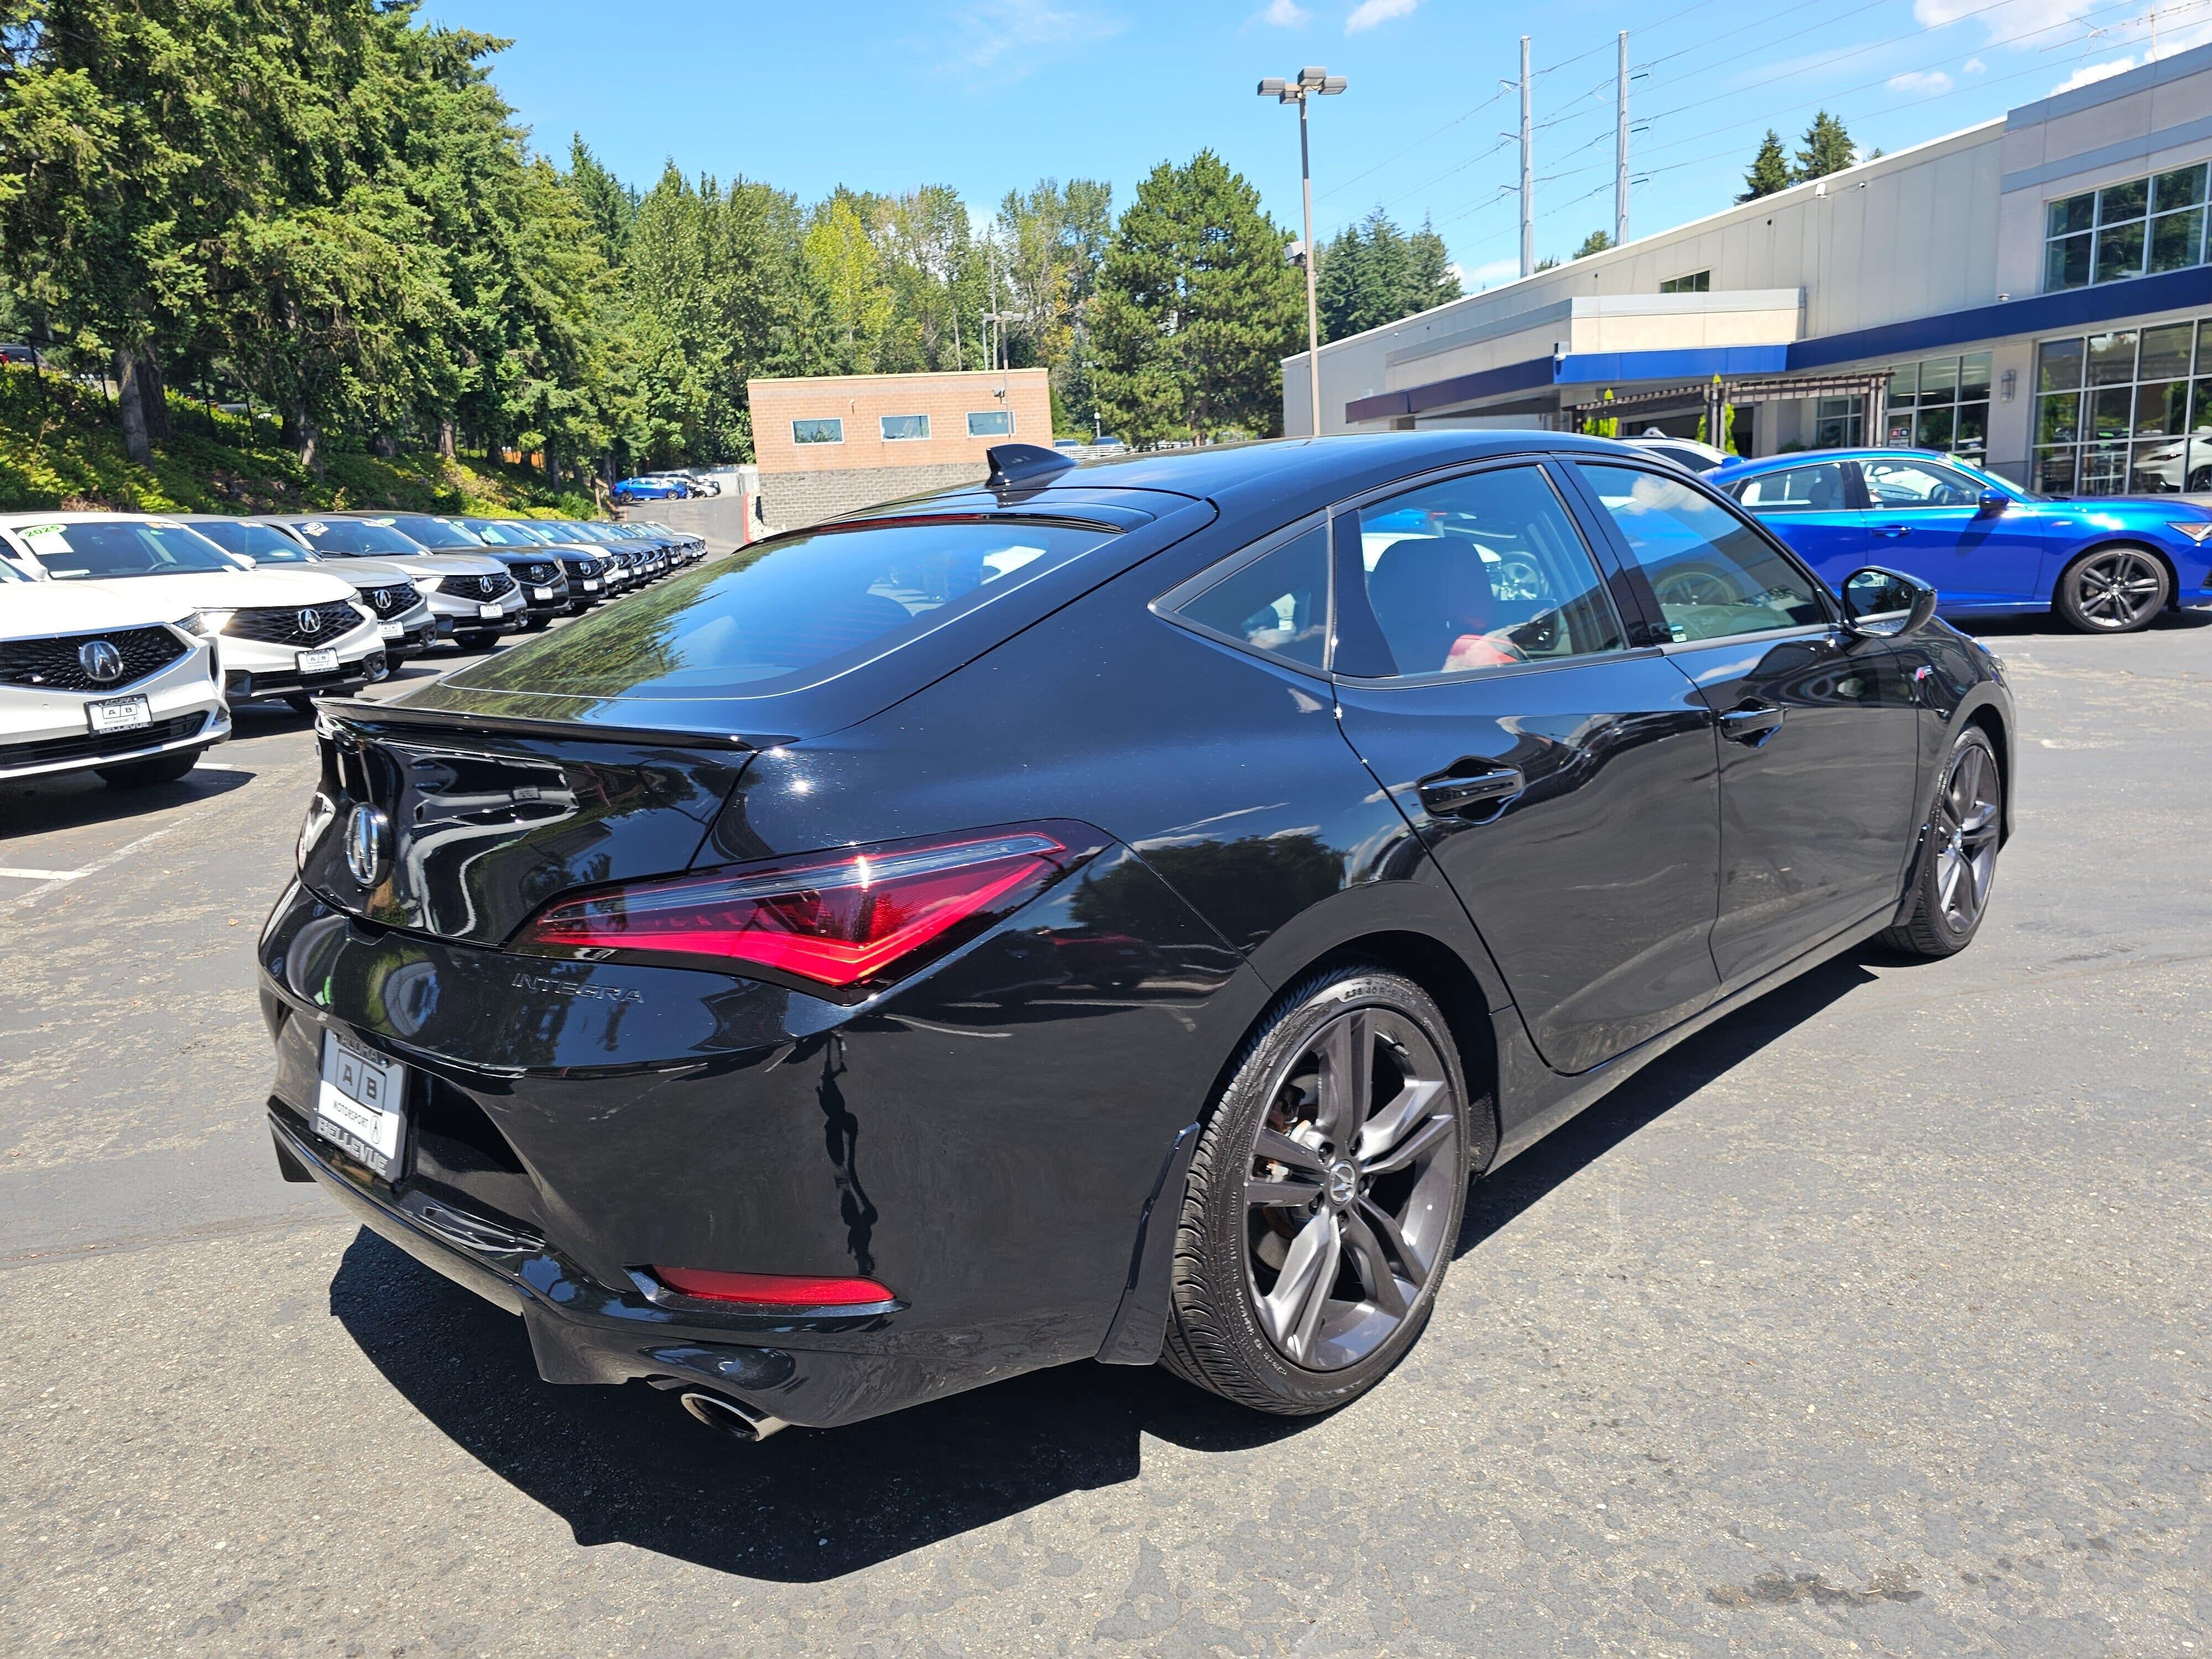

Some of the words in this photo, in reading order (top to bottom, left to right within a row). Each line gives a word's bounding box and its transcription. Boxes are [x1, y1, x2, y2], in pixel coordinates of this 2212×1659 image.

[24, 525, 59, 537] 2025
[99, 722, 150, 735] BELLEVUE
[512, 973, 644, 1004] INTEGRA
[342, 1063, 353, 1087] A
[367, 1076, 377, 1100] B
[316, 1116, 387, 1176] BELLEVUE
